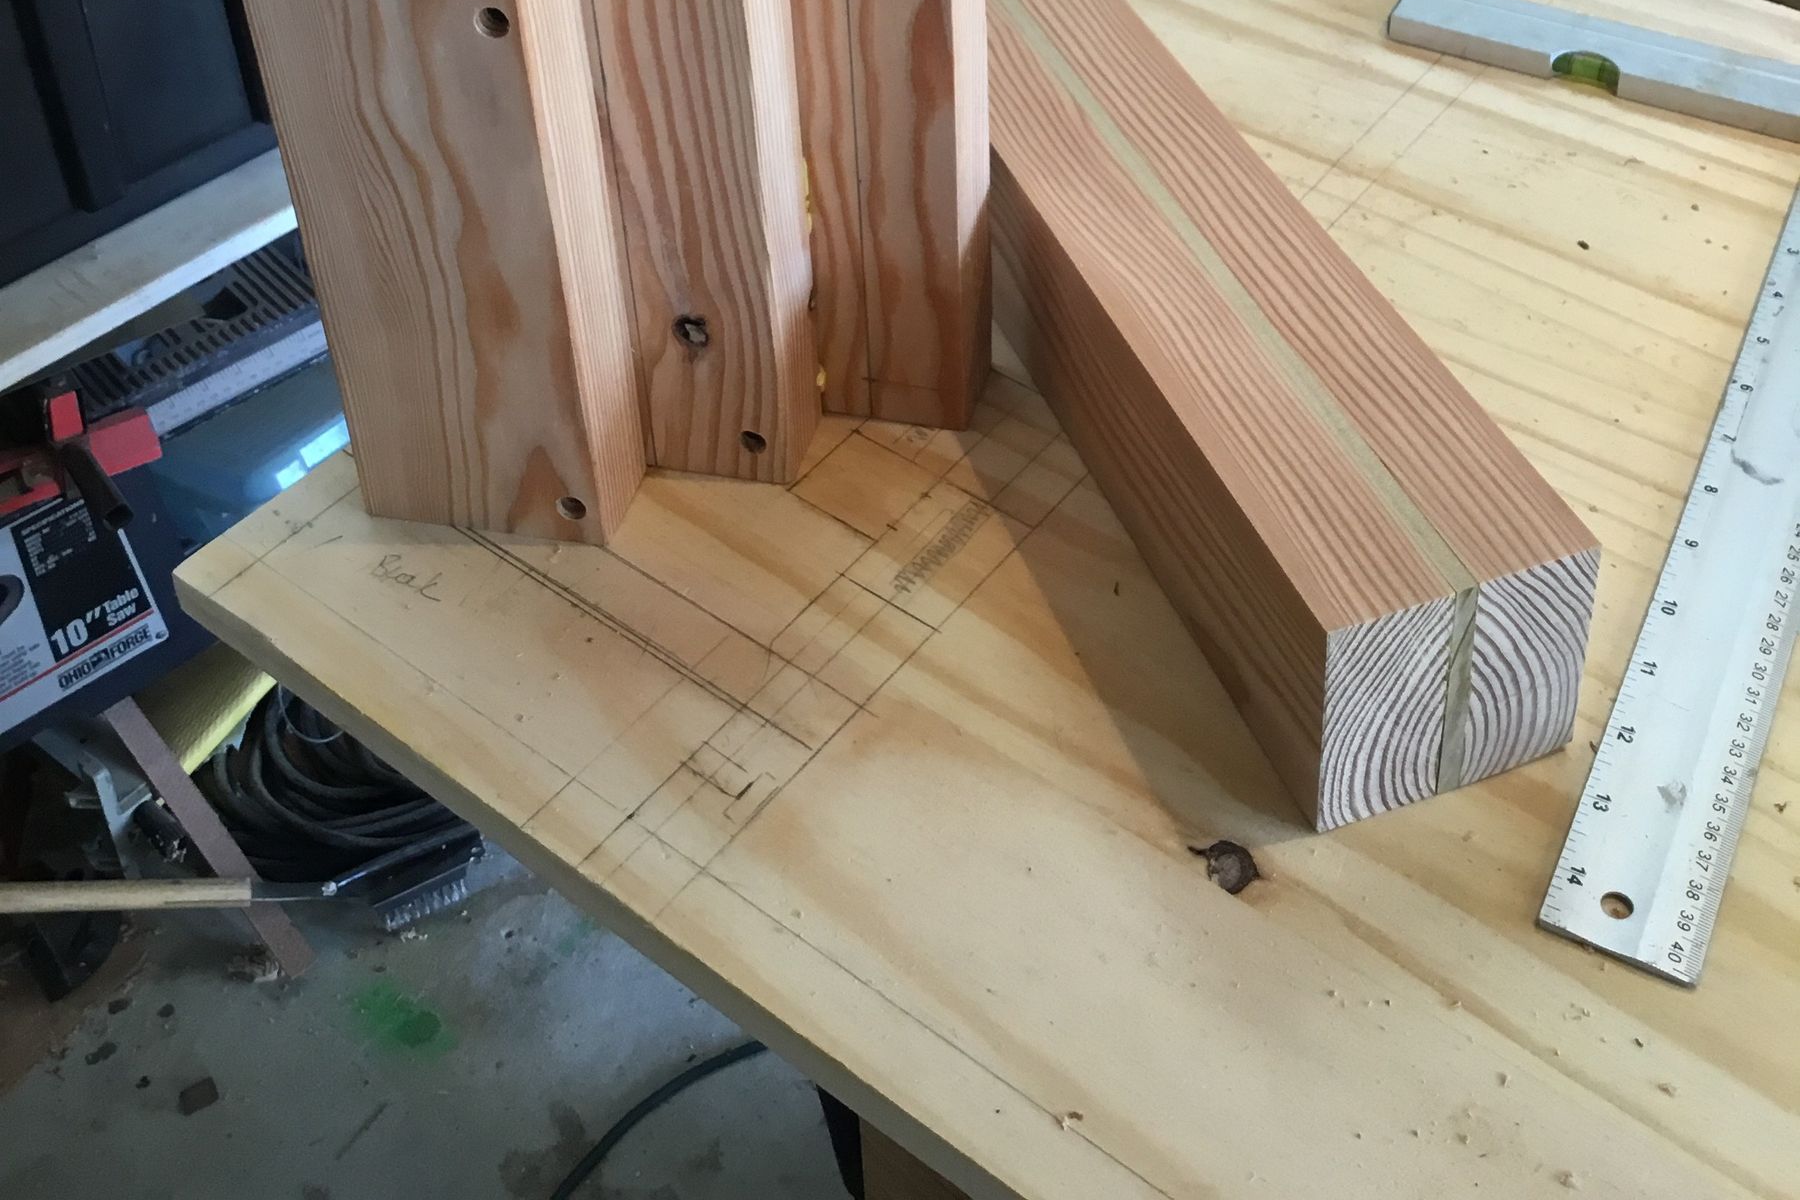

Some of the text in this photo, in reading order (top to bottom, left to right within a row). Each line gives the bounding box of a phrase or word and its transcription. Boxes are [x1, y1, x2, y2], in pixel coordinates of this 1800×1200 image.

[1773, 291, 1784, 299] 4
[1756, 336, 1770, 345] 5
[1740, 383, 1754, 392] 6
[1723, 433, 1737, 442] 7
[1704, 484, 1719, 493] 8
[1684, 538, 1699, 548] 9
[102, 587, 140, 613] Table
[1660, 599, 1678, 616] 10
[106, 602, 137, 627] Saw
[58, 658, 93, 689] OHIO
[107, 626, 152, 662] FORGE
[1640, 661, 1658, 677] 11
[1616, 725, 1636, 744] 12
[1667, 545, 1800, 964] 25 26 27 28 29 30 31 32 33 34 35 36 37 38 39 40
[1592, 793, 1612, 813] 13
[1567, 866, 1587, 887] 14
